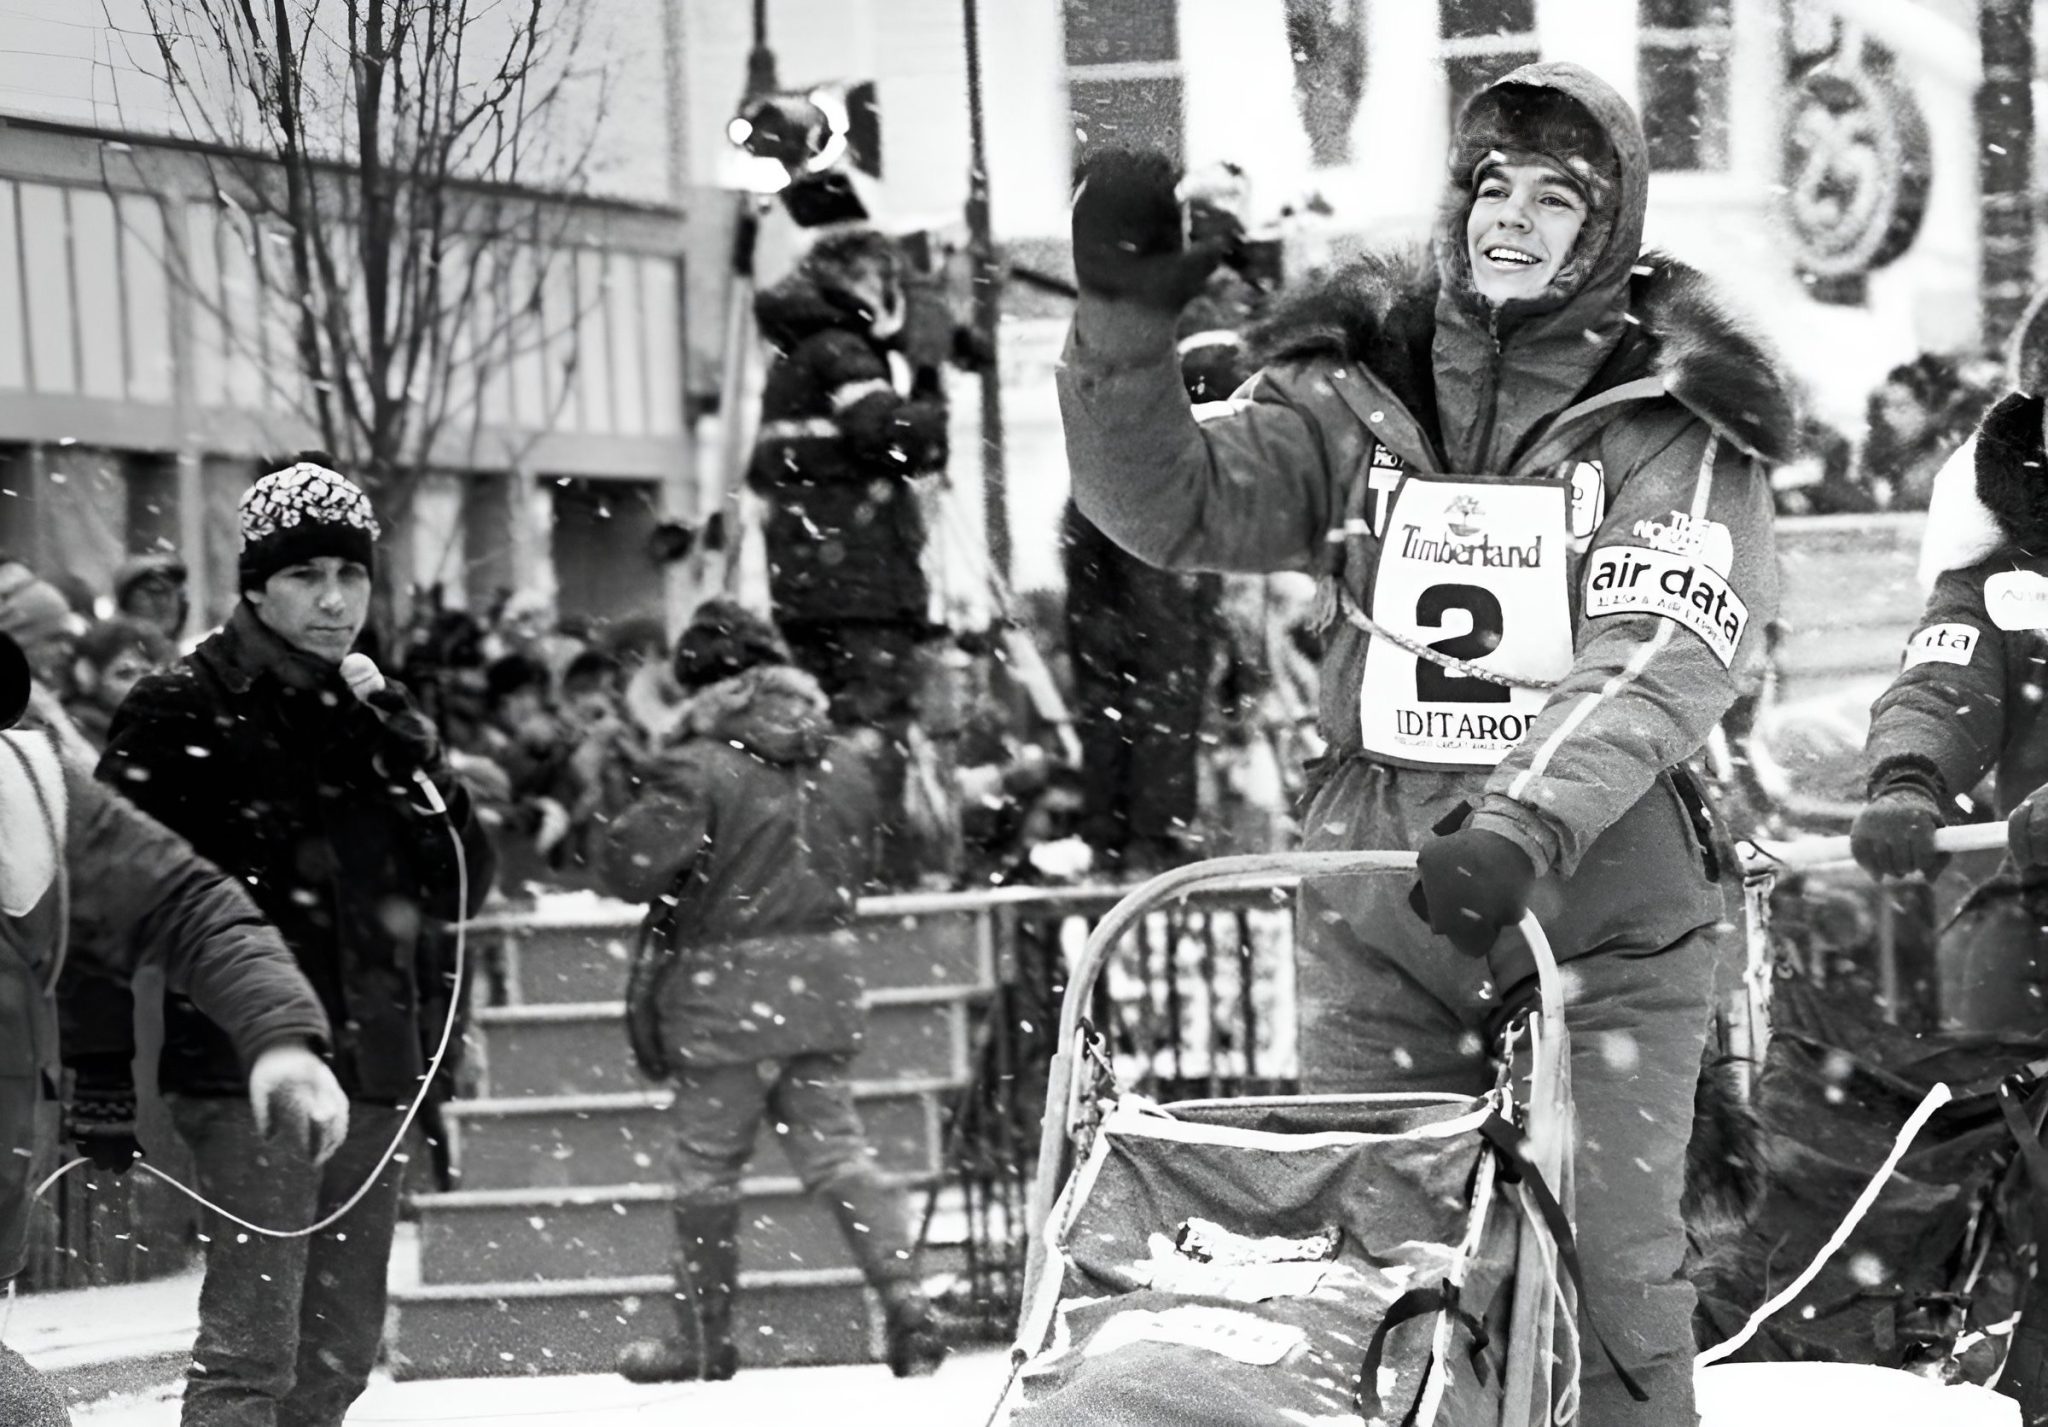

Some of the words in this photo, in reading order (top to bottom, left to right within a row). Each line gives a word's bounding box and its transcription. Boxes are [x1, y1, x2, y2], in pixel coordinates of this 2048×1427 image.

[1401, 523, 1542, 568] Timberland
[1415, 583, 1511, 703] 2
[1592, 553, 1652, 591] air
[1660, 566, 1740, 646] data
